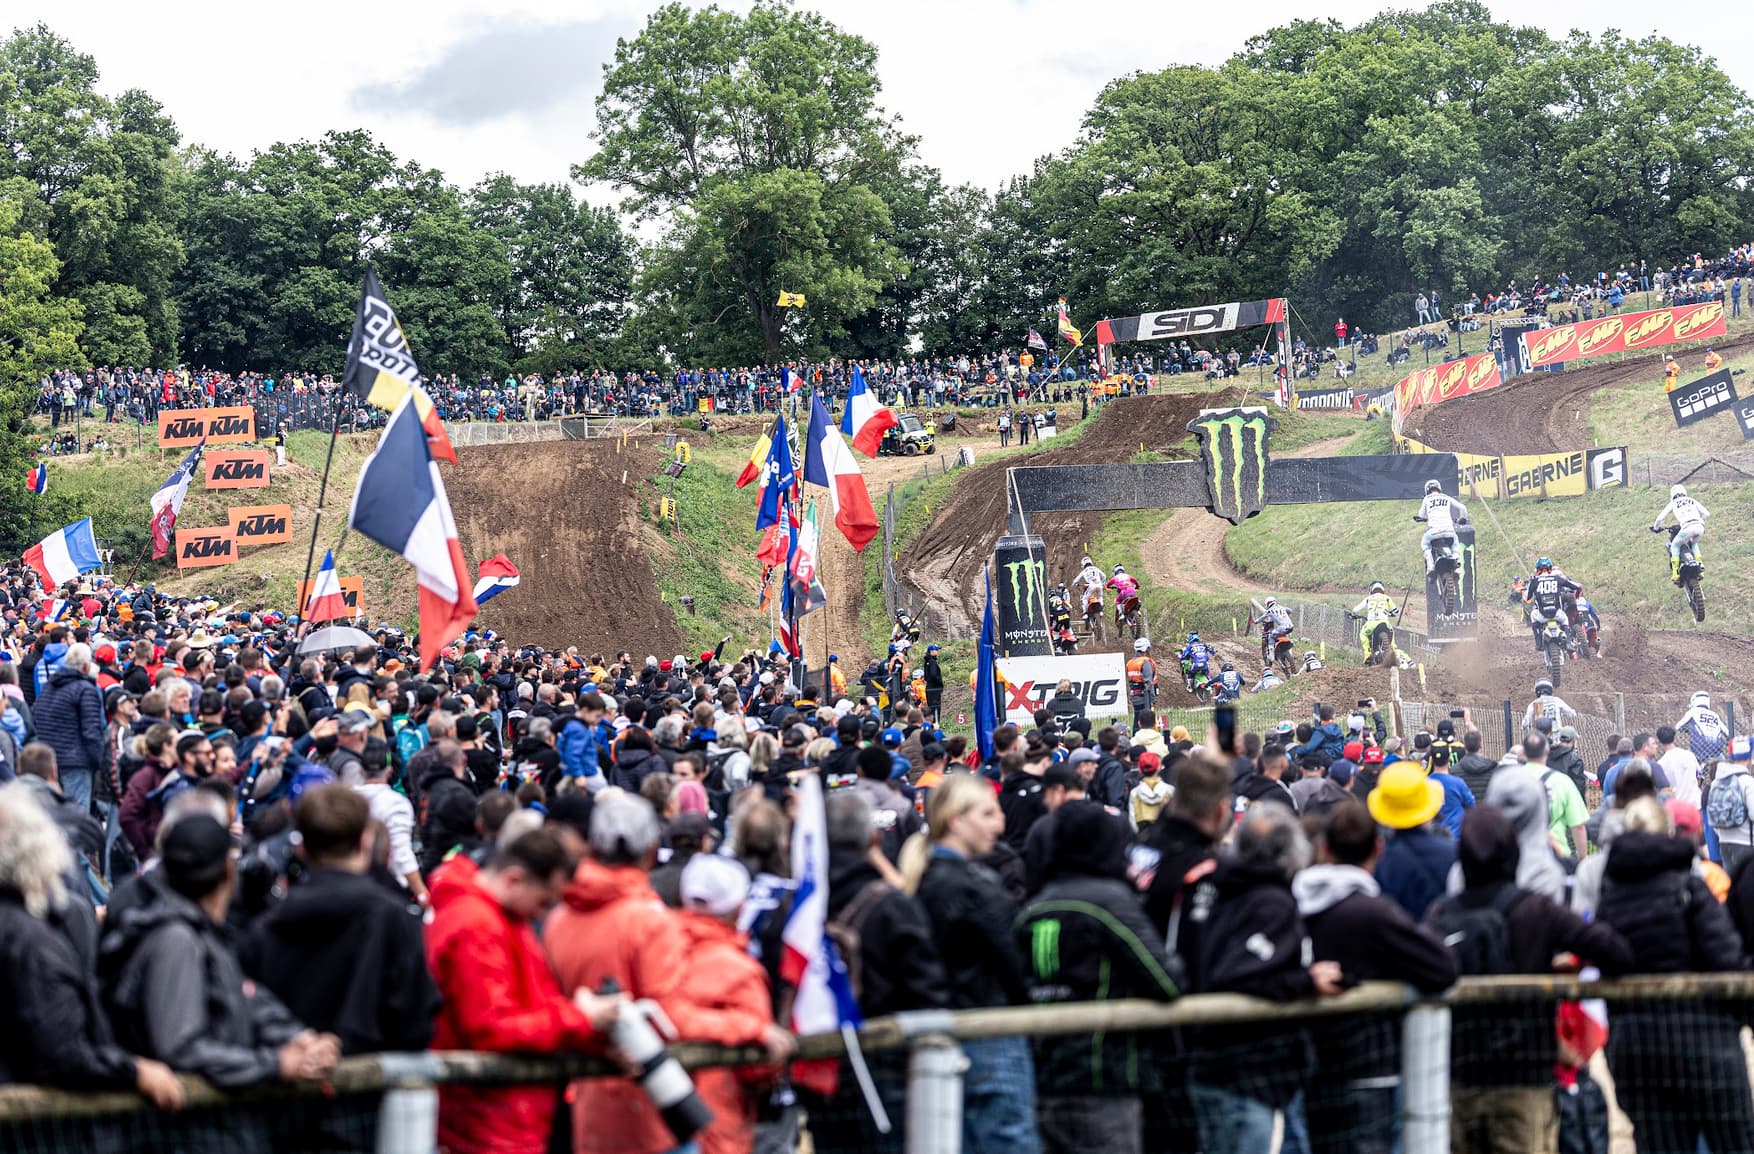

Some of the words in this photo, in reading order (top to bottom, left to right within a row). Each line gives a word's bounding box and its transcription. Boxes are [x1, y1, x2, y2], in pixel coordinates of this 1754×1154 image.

[1531, 327, 1575, 363] FMF
[1578, 319, 1622, 354] FMF
[1624, 311, 1672, 345] FMF
[1674, 303, 1723, 337] FMF
[1676, 381, 1727, 407] GoPro
[164, 418, 204, 439] KTM
[208, 415, 250, 436] KTM
[212, 459, 264, 480] KTM
[1506, 453, 1583, 495] GAERNE
[237, 514, 286, 536] KTM
[183, 536, 231, 558] KTM
[1537, 581, 1558, 594] 408
[958, 713, 965, 724] 5
[1699, 713, 1719, 726] 524
